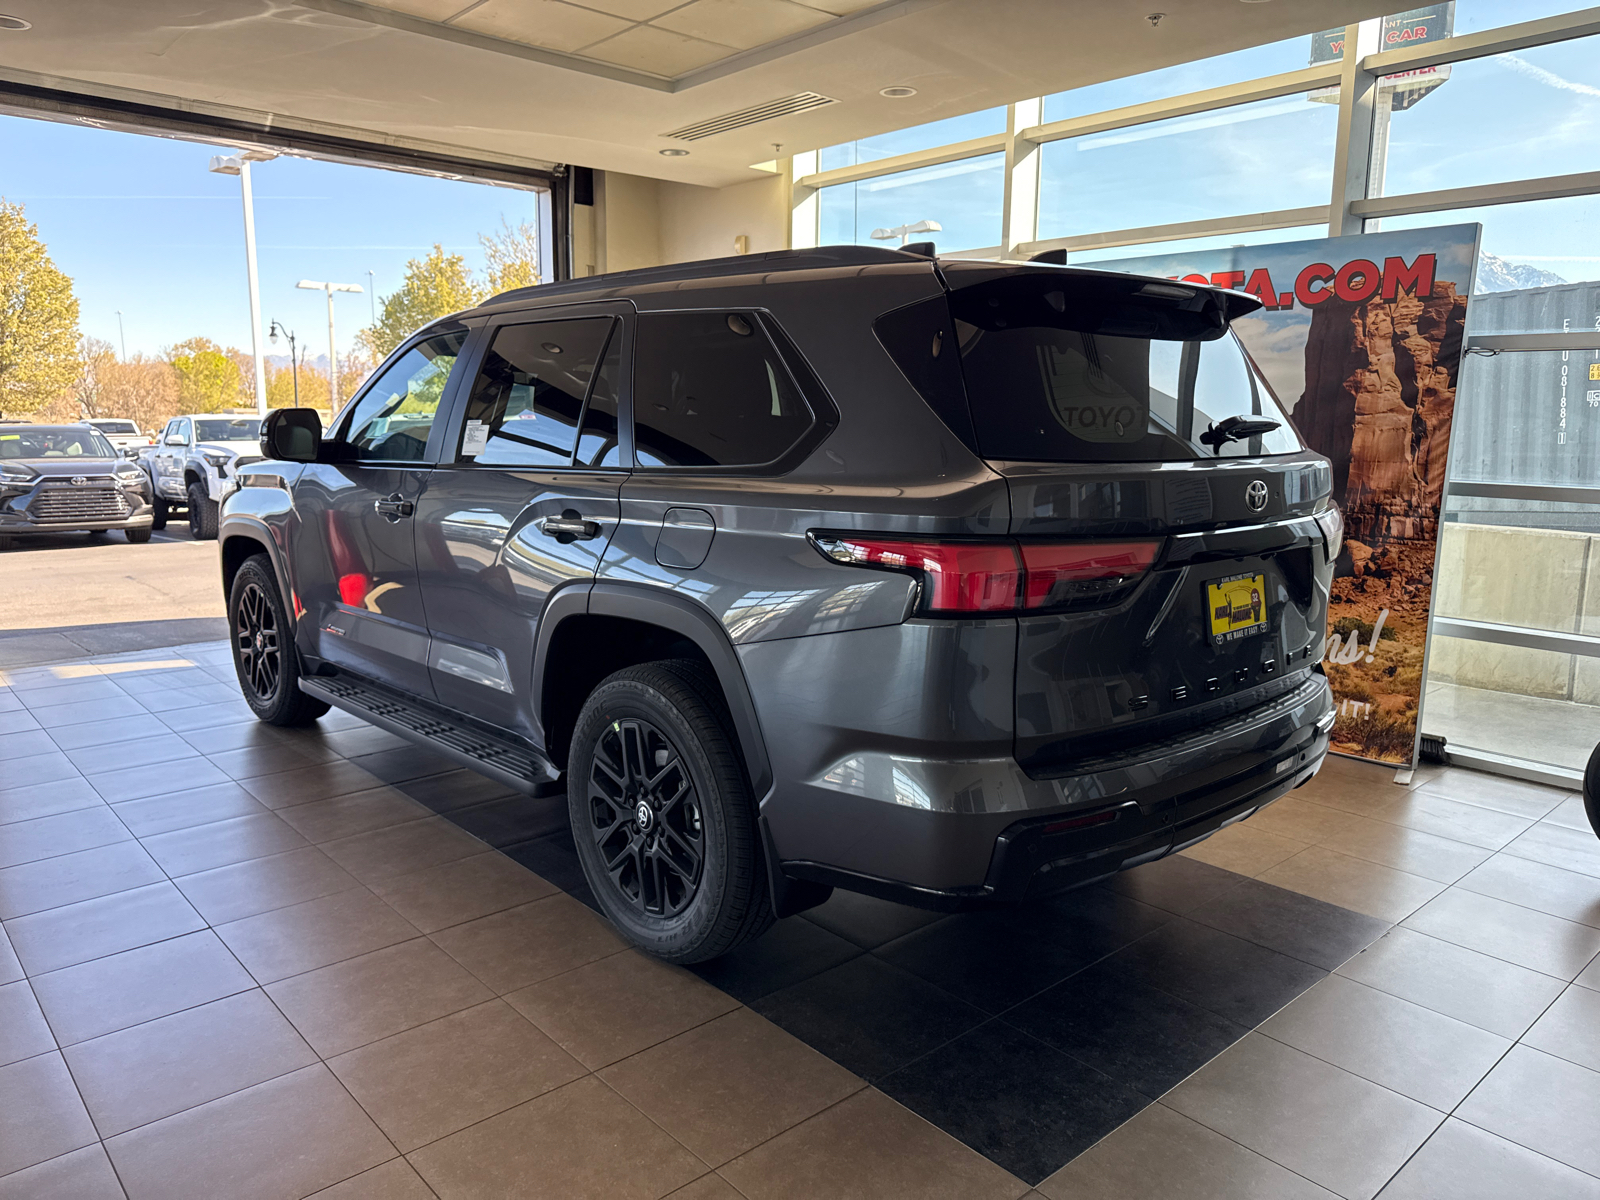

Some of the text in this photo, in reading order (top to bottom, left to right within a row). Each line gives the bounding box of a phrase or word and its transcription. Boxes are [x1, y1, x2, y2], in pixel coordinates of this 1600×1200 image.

[1330, 26, 1428, 54] Y CAR
[1166, 252, 1437, 312] TA.COM
[1252, 593, 1259, 602] 32
[1127, 644, 1313, 712] SEQUOIA
[1341, 699, 1370, 720] IT!
